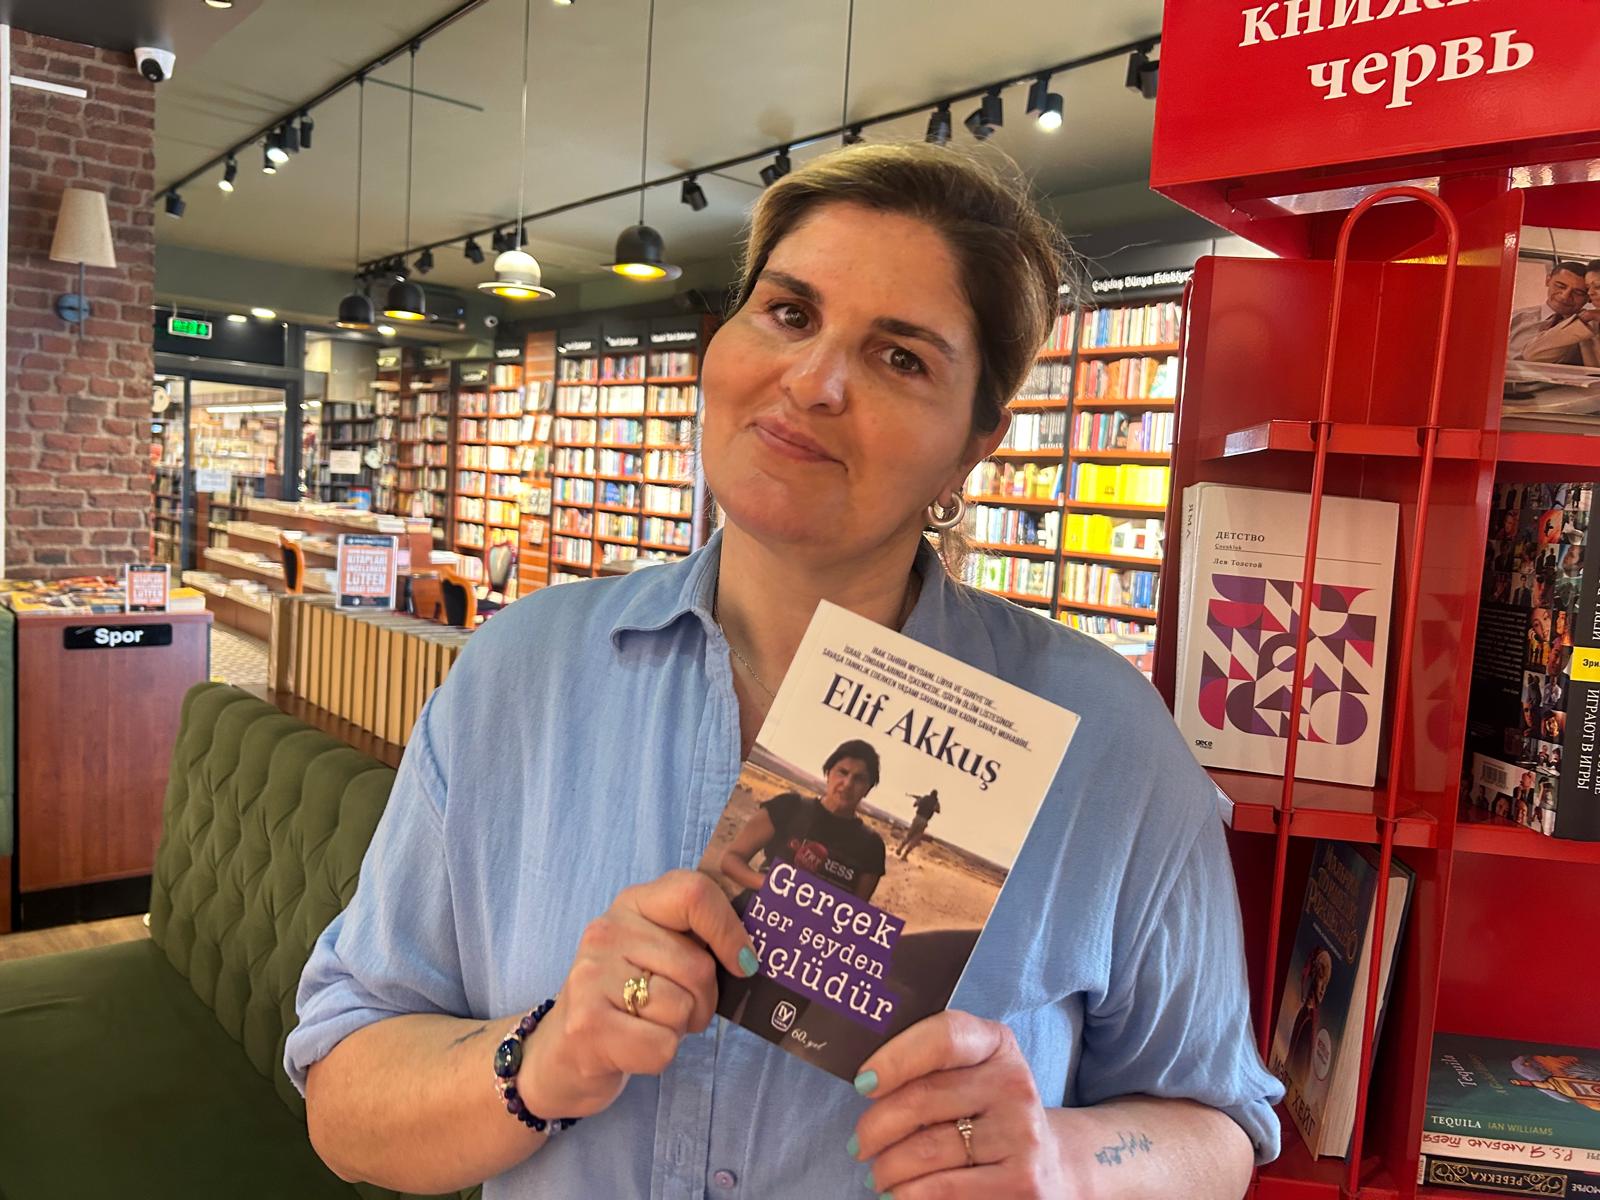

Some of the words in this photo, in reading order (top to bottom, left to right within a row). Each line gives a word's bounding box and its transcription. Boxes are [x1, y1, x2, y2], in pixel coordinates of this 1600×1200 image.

[1307, 29, 1534, 109] червь
[1124, 276, 1153, 288] Dünya
[1216, 531, 1265, 542] ДЕТСТВО
[1231, 559, 1263, 568] Толстой
[94, 628, 144, 648] Spor
[1583, 689, 1600, 742] ИГРАЮТ
[822, 672, 890, 728] Elif
[886, 708, 1001, 791] Akkuş
[1581, 743, 1594, 752] В
[1577, 755, 1593, 790] ИГРЫ
[769, 863, 897, 950] Gerçek
[749, 896, 793, 933] her
[798, 926, 884, 980] şeyden
[749, 929, 893, 1022] üçlüdür
[1431, 1115, 1482, 1129] TEQUILA
[1488, 1121, 1504, 1130] IAN
[1507, 1123, 1553, 1136] WILLIAMS
[1530, 1146, 1546, 1158] Я
[1470, 1171, 1523, 1186] РЕБЕККА
